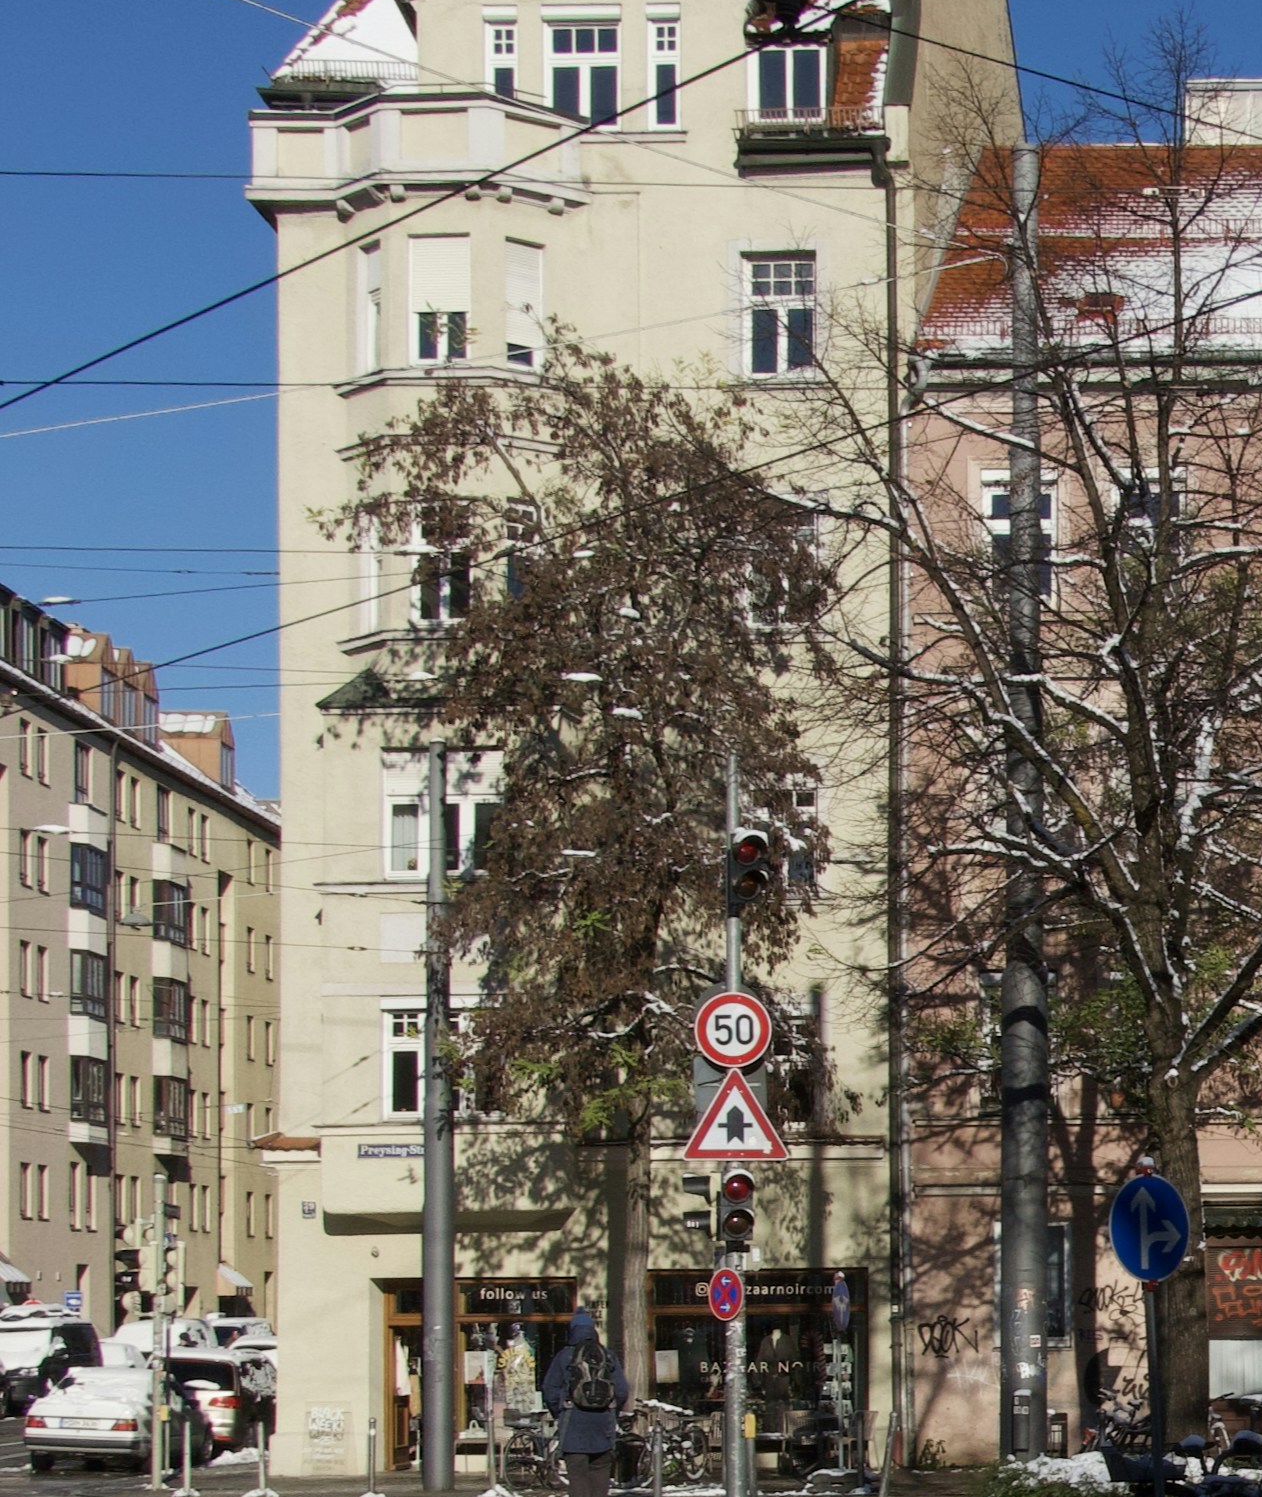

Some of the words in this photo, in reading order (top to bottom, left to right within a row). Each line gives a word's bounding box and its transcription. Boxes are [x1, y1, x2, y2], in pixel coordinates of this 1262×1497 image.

[714, 1014, 754, 1046] 50
[480, 1288, 525, 1300] follow
[532, 1289, 548, 1300] us
